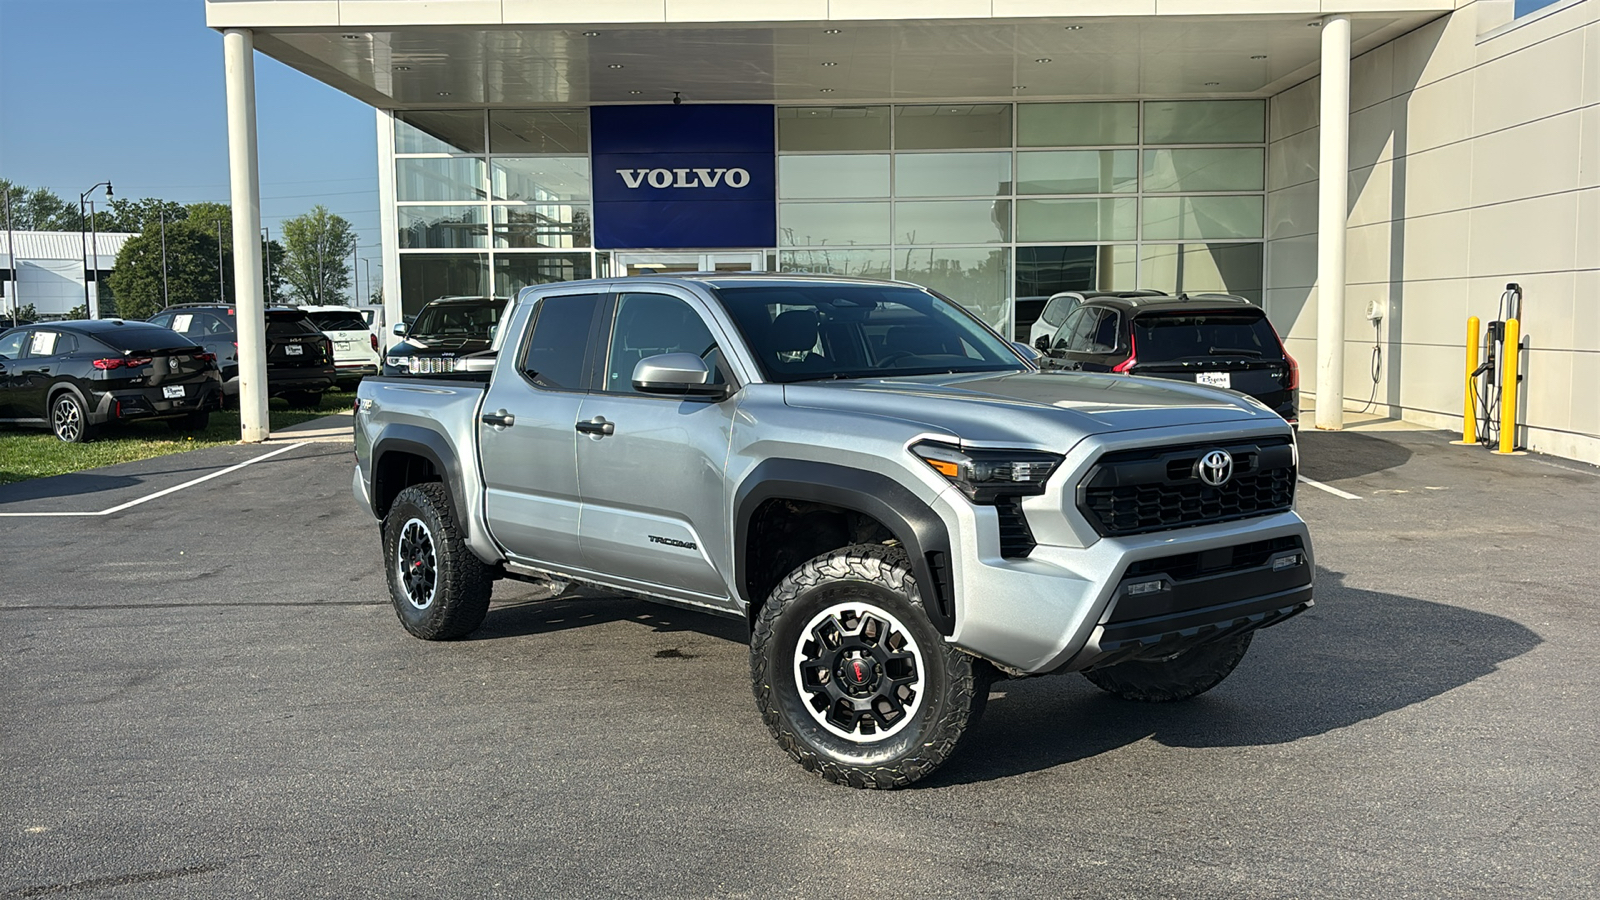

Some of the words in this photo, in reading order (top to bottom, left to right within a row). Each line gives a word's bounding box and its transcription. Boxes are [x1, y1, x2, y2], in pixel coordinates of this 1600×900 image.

[615, 167, 750, 189] VOLVO
[781, 264, 809, 274] Cars
[648, 534, 698, 550] TACOMA
